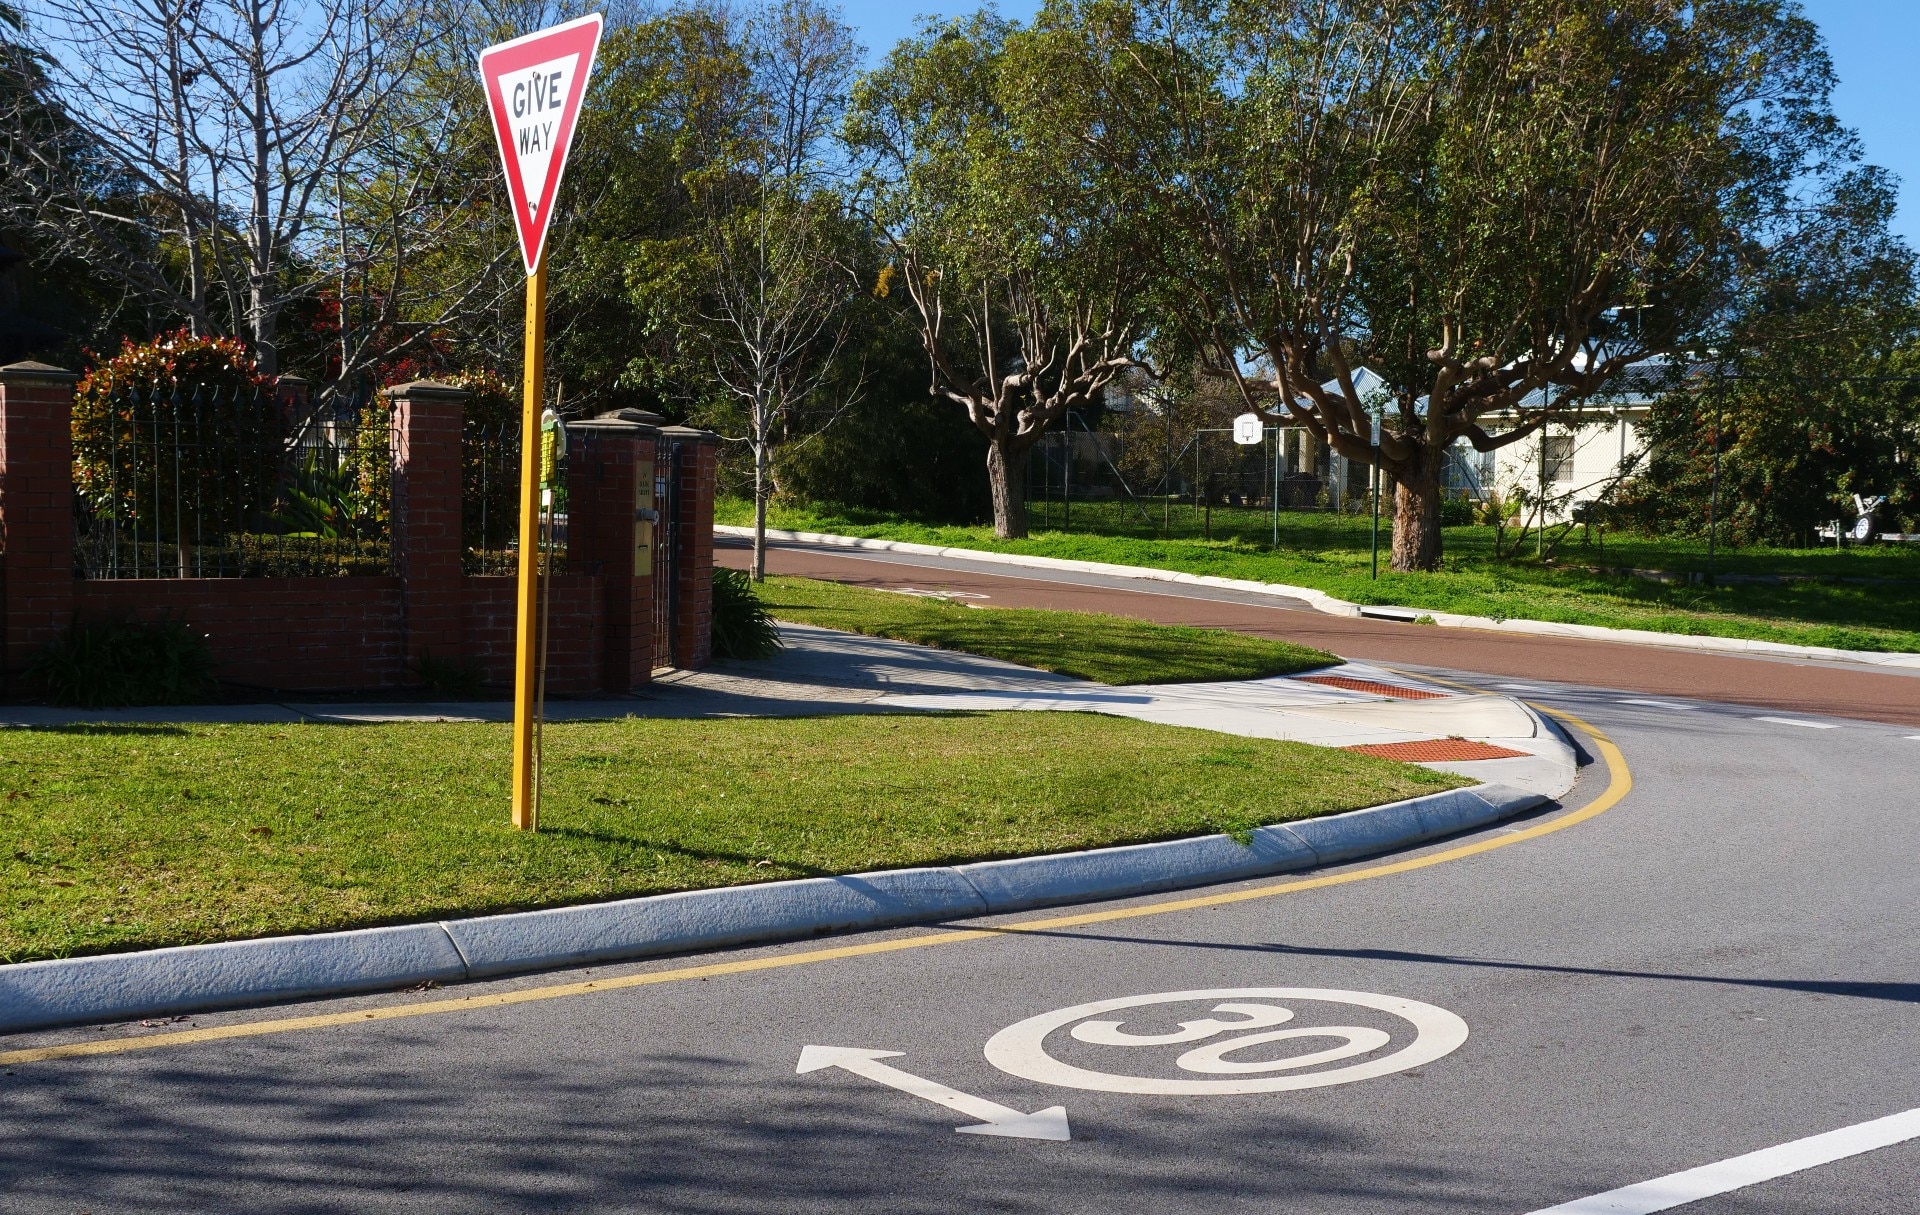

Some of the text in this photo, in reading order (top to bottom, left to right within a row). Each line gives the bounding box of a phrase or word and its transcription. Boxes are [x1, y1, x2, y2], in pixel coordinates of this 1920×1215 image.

[513, 71, 562, 119] GIVE
[519, 121, 552, 156] WAY
[1070, 1003, 1391, 1074] 30
